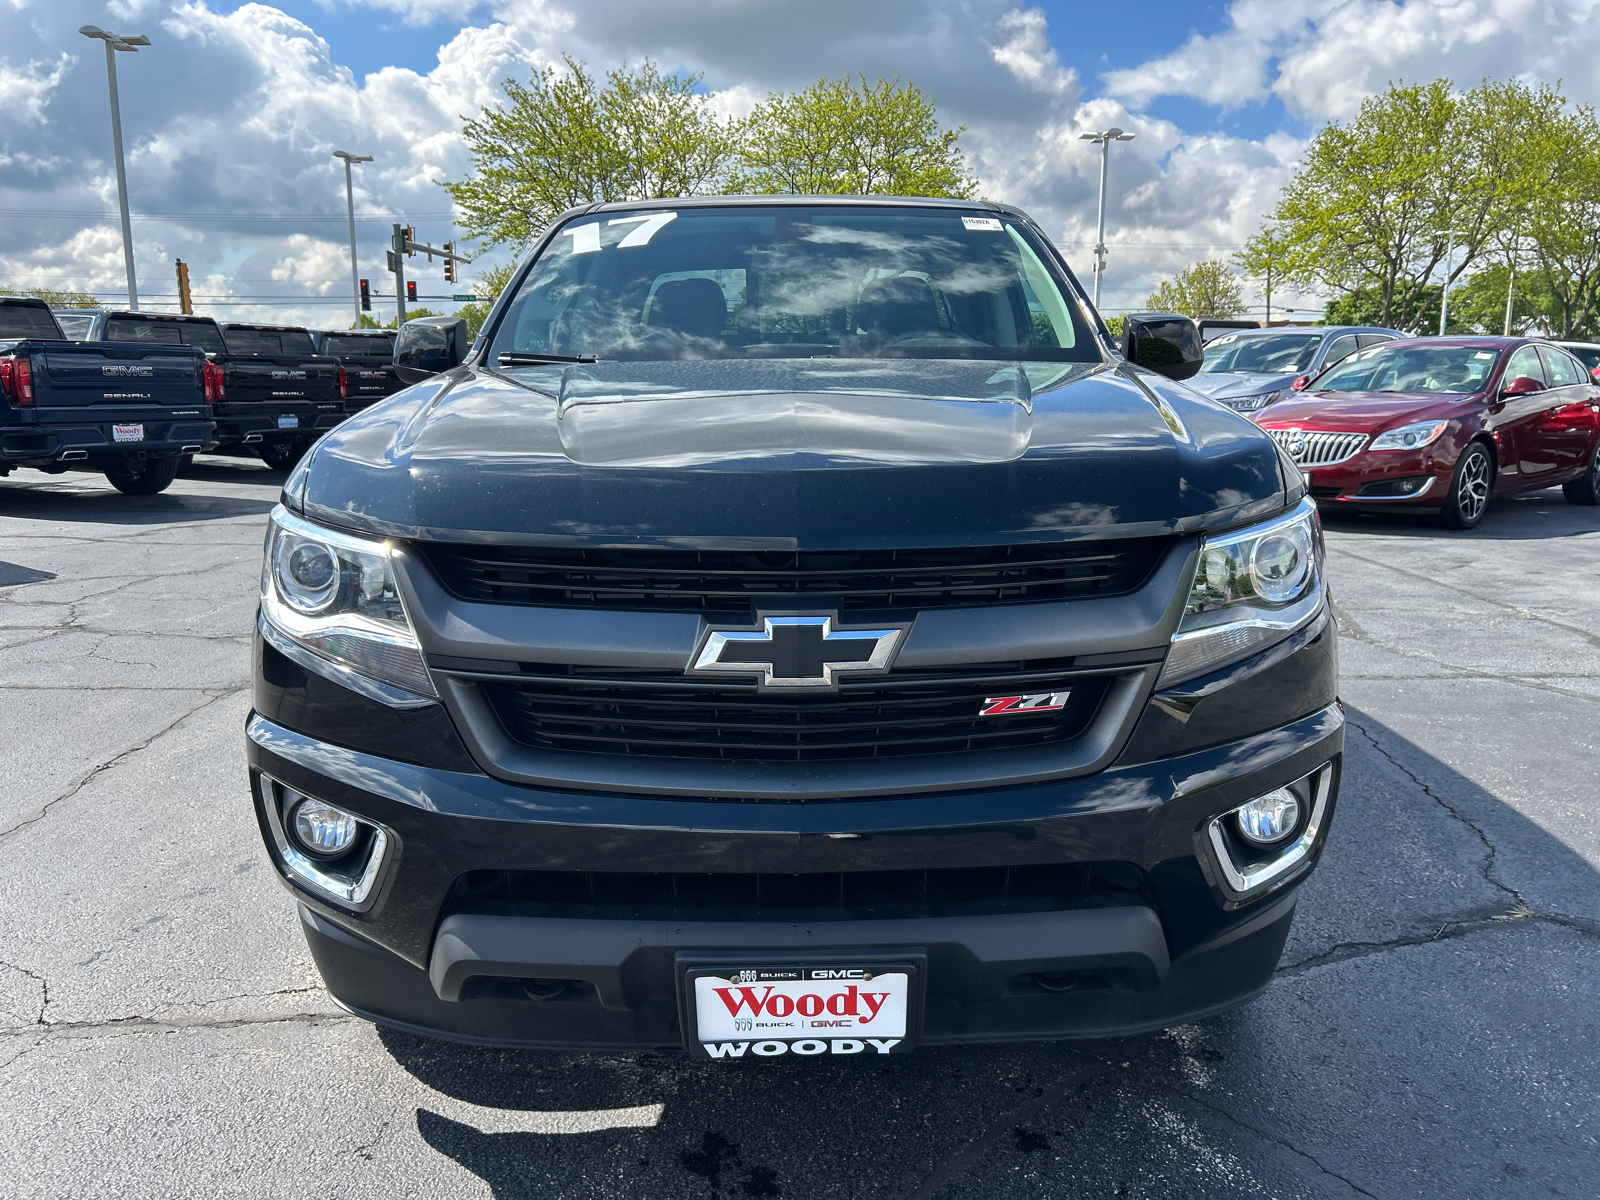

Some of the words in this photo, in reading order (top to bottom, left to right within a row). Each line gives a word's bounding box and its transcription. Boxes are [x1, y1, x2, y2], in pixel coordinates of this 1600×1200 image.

[563, 212, 677, 254] 17
[1345, 346, 1385, 363] 17
[102, 365, 153, 376] GMC
[271, 370, 306, 380] GMC
[359, 371, 386, 379] GMC
[115, 427, 140, 435] Woody
[978, 691, 1071, 716] Z71
[811, 969, 864, 979] GMC
[712, 985, 891, 1024] Woody
[810, 1020, 852, 1028] GMC
[702, 1039, 902, 1058] WOODY
